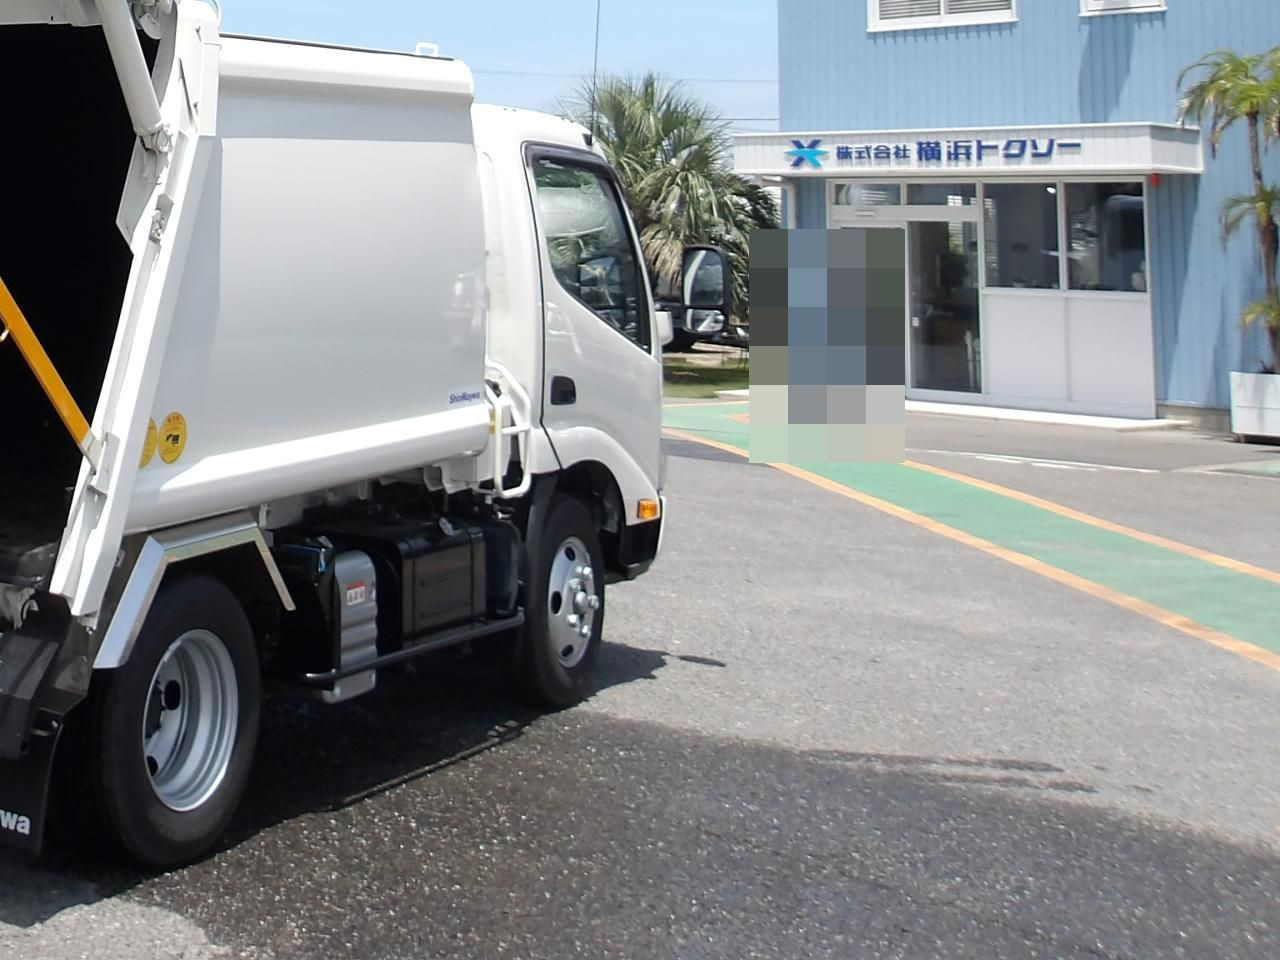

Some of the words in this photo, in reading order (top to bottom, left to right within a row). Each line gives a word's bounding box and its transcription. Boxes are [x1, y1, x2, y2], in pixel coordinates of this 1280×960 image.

[835, 144, 911, 160] 株式会社
[916, 138, 1082, 162] 横浜トクソー
